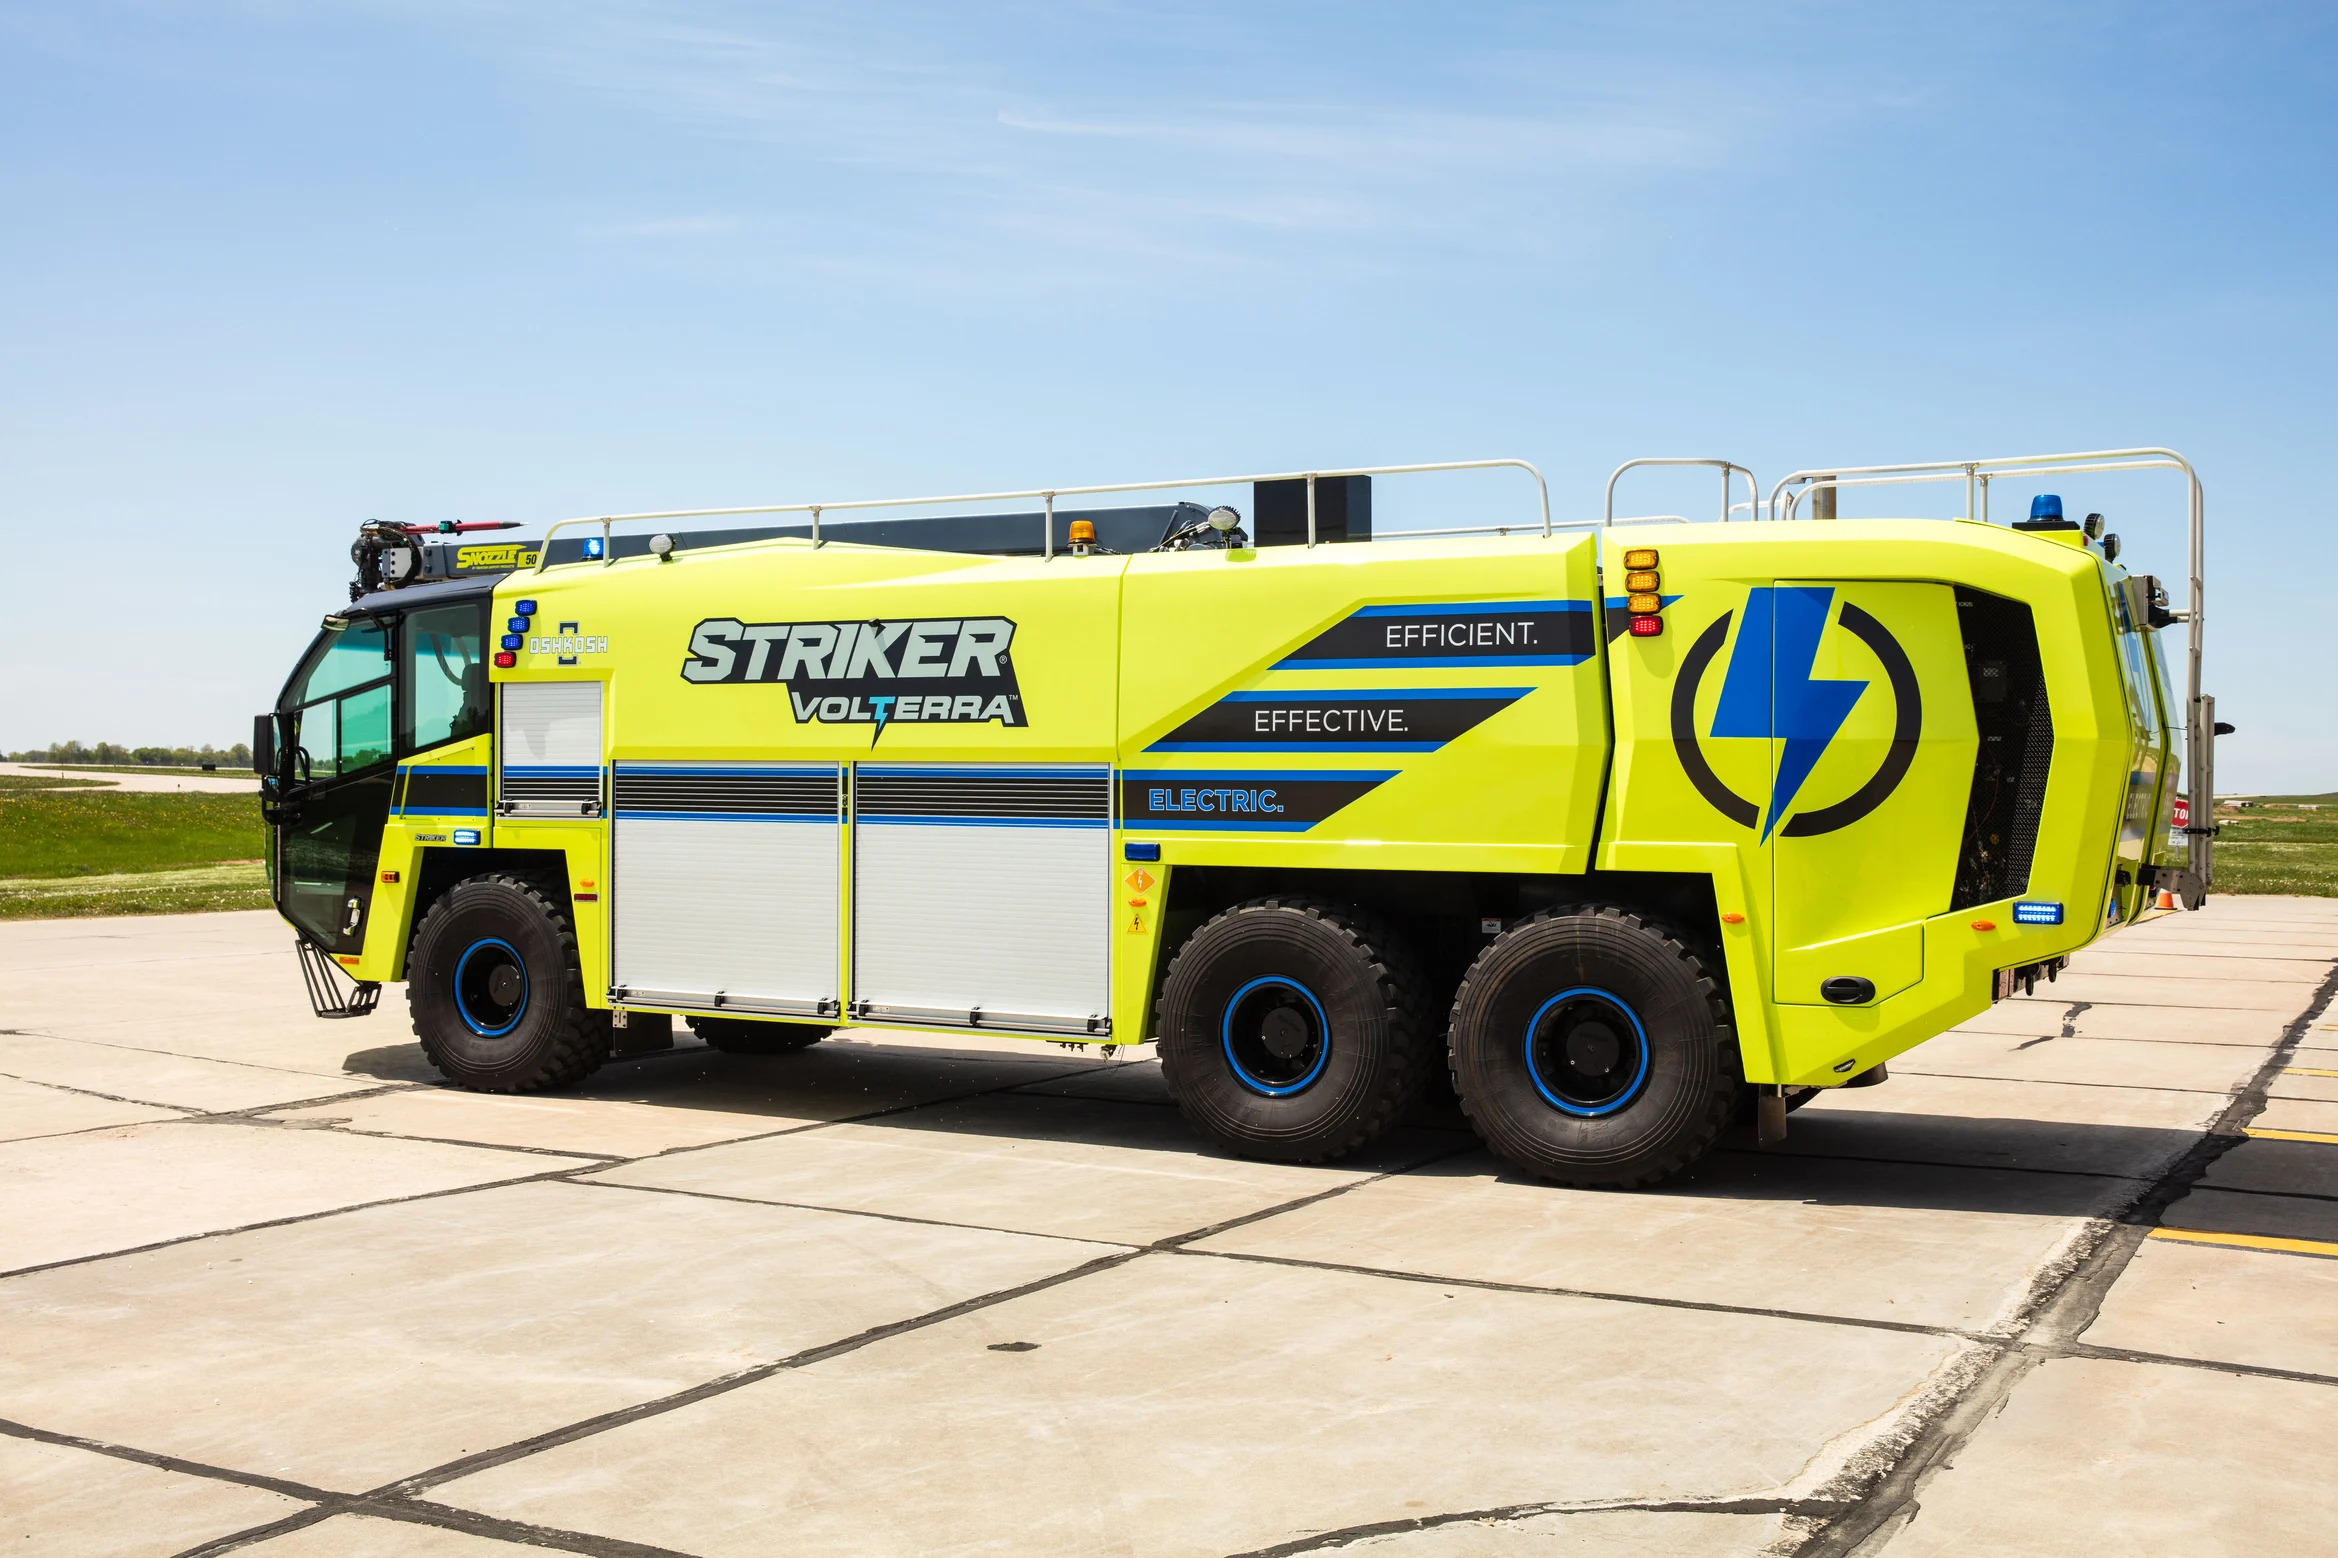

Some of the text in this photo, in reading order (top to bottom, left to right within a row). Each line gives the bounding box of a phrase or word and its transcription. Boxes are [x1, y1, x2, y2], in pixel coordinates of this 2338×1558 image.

[525, 553, 537, 565] 50
[529, 635, 608, 654] OSHKOSH
[1385, 621, 1539, 649] EFFICIENT.
[1254, 708, 1409, 733] EFFECTIVE.
[1148, 788, 1285, 813] ELECTRIC.
[414, 833, 447, 842] STRIKER
